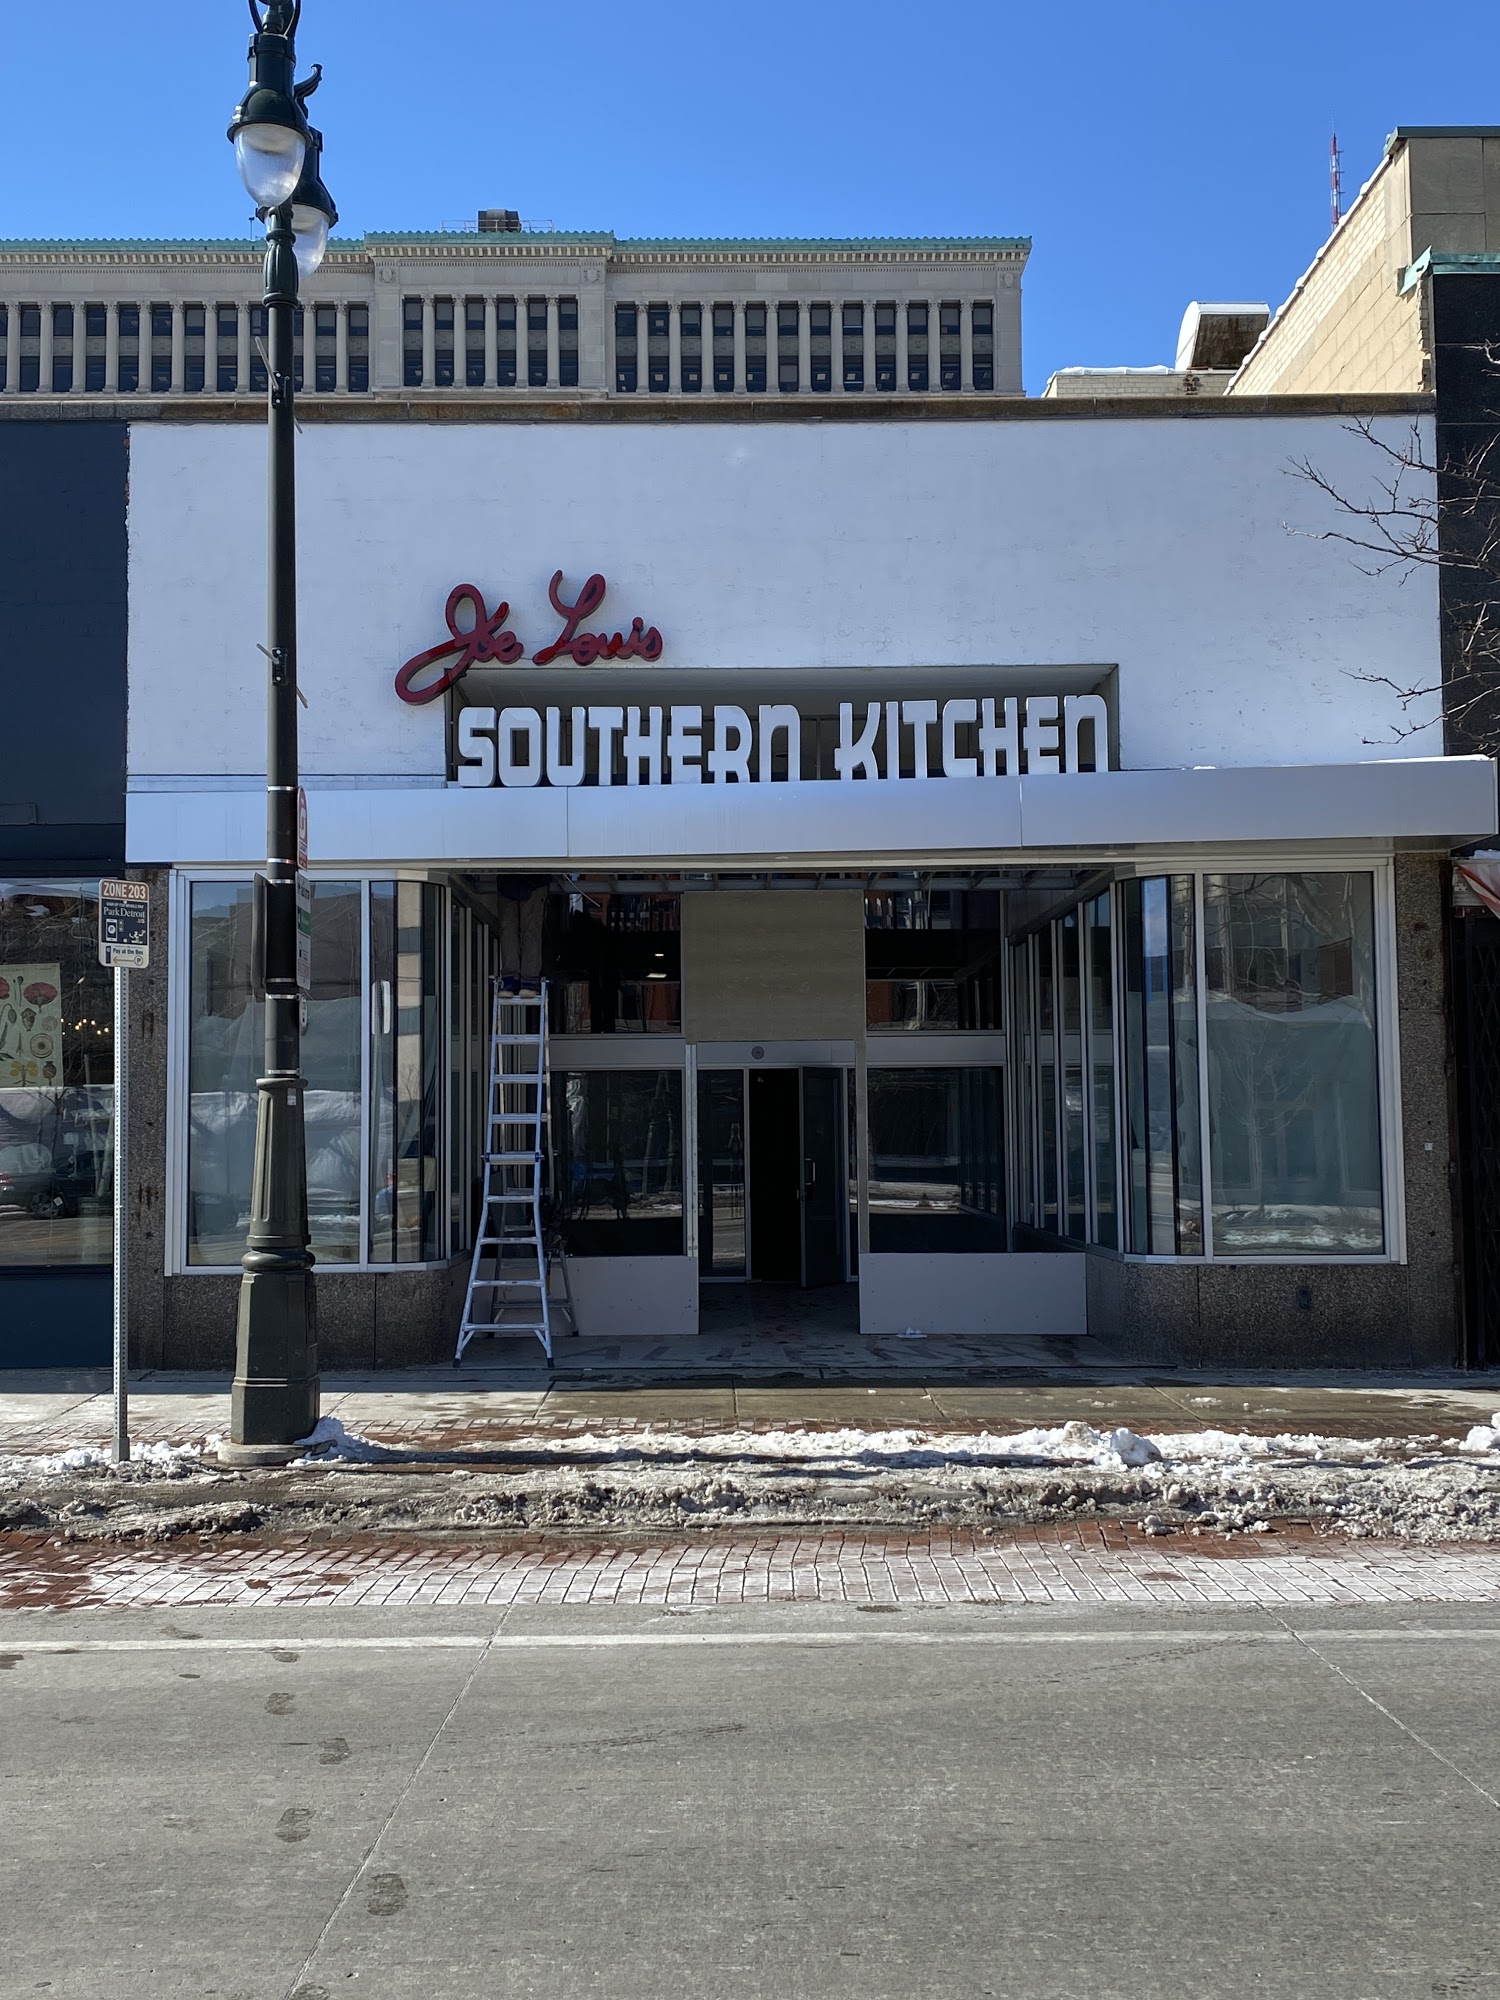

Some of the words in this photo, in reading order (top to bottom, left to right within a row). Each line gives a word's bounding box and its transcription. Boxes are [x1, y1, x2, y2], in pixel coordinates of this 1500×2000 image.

[395, 583, 524, 704] Joe
[532, 569, 664, 666] Louis
[457, 705, 800, 787] SOUTHERN
[835, 694, 1108, 780] KITCHEN
[103, 882, 127, 897] ZONE
[128, 885, 146, 899] 203
